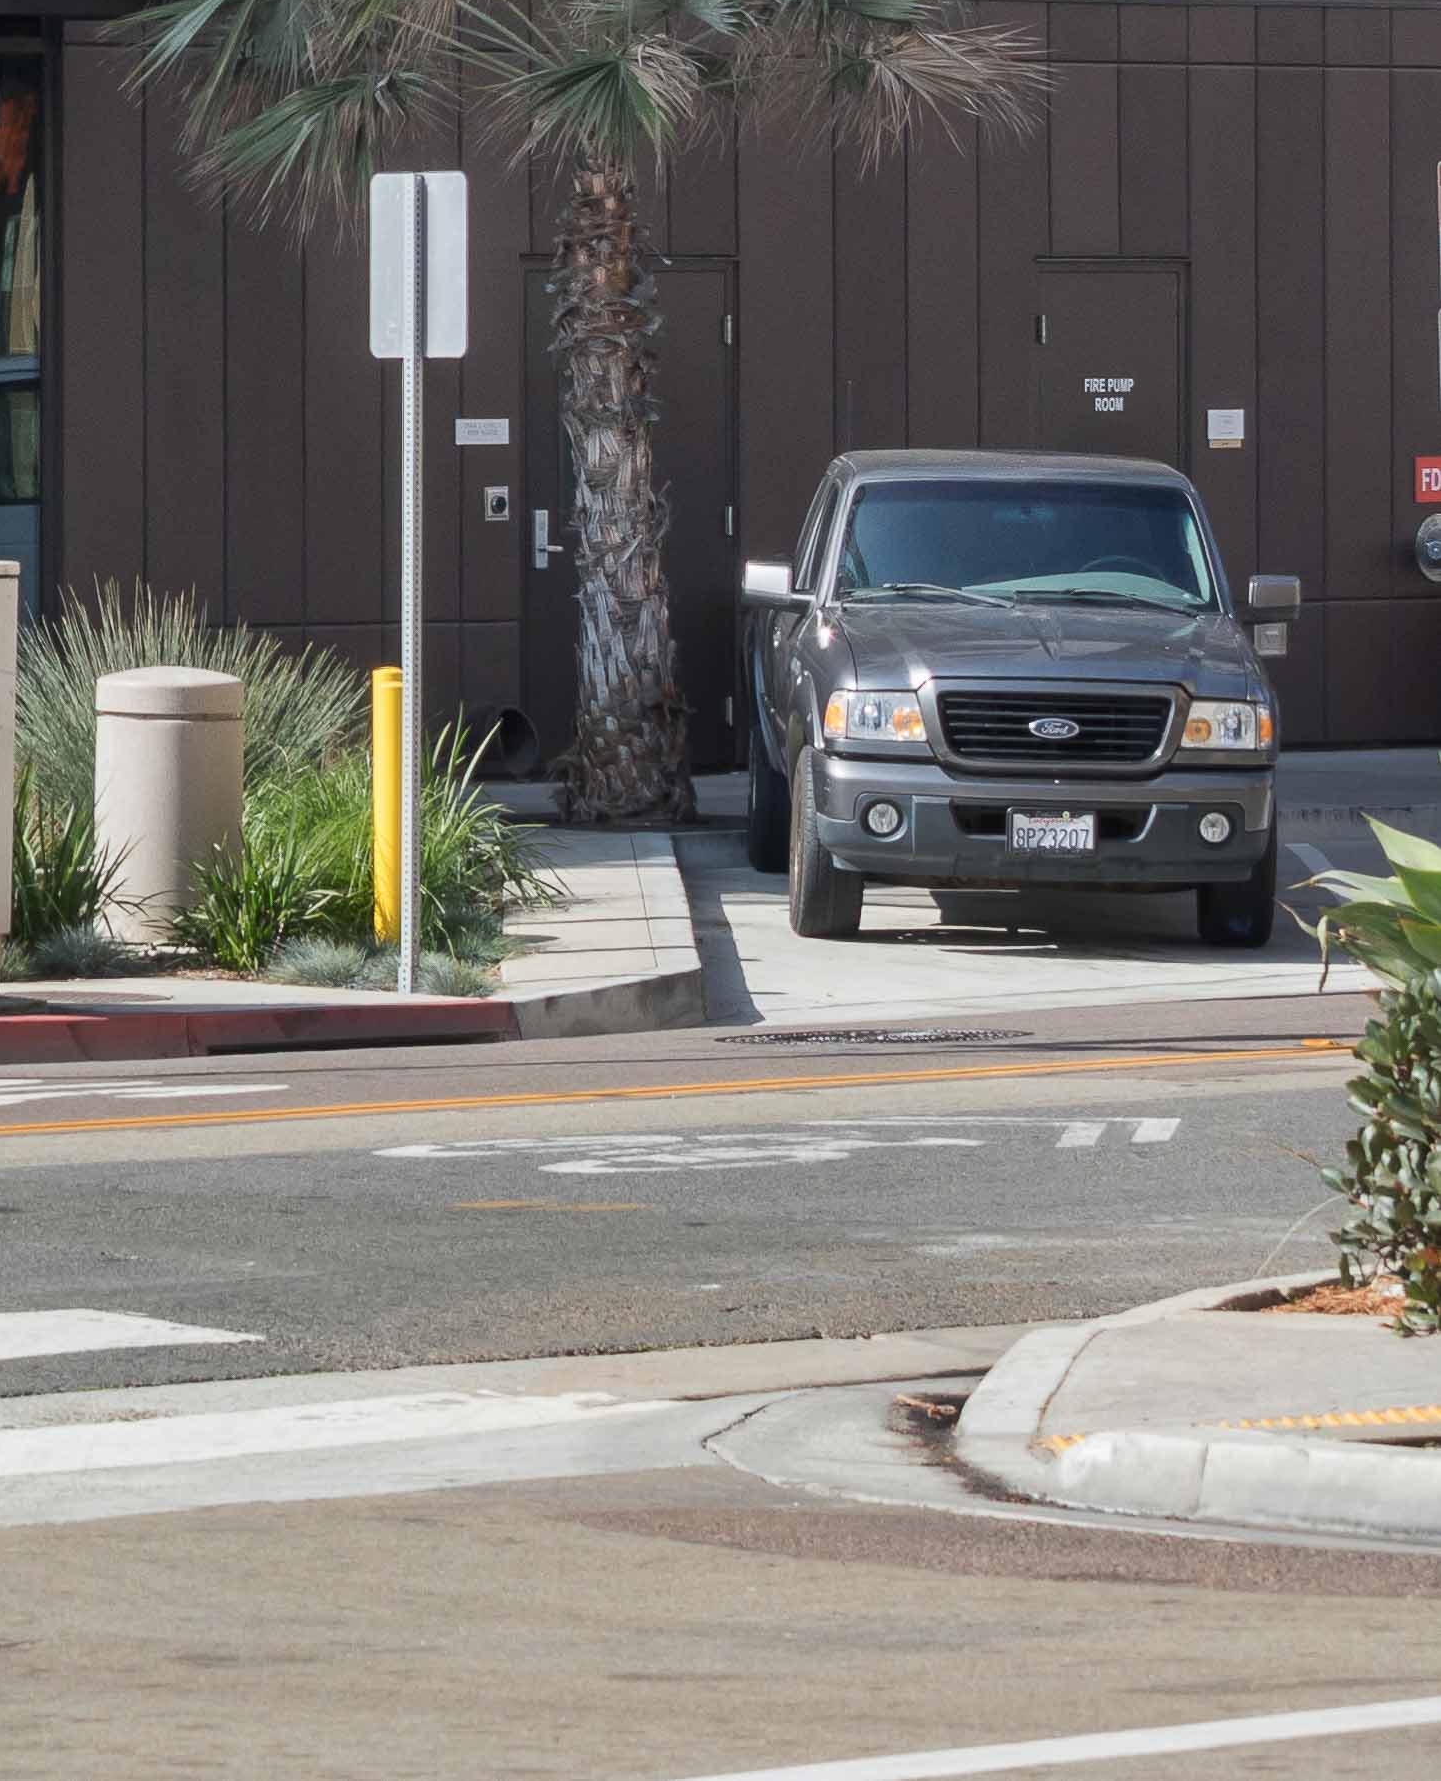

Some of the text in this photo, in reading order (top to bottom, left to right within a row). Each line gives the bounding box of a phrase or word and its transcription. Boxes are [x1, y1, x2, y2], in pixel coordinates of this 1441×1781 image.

[1084, 378, 1134, 393] FIRE PUMP
[1094, 397, 1124, 412] ROOM
[1016, 827, 1090, 850] 8P23207
